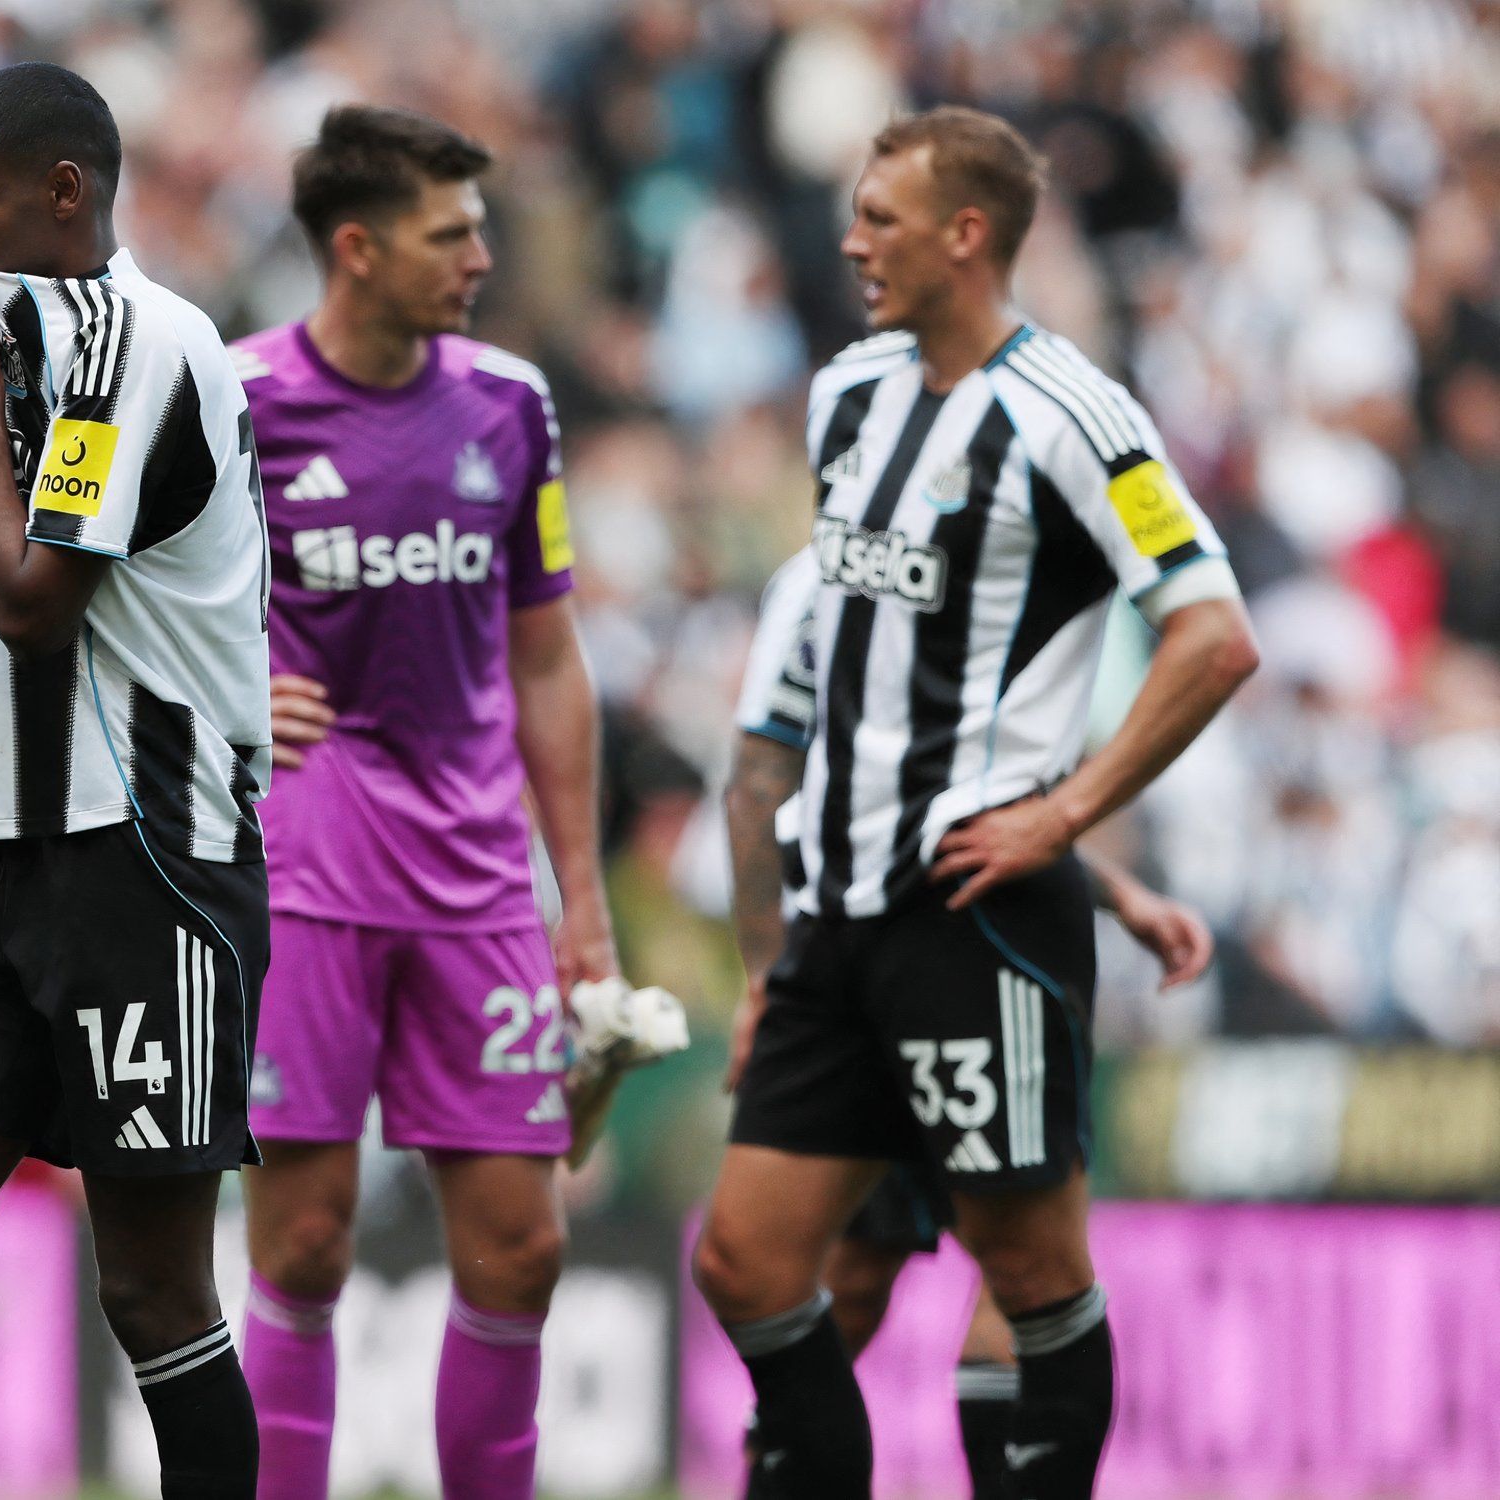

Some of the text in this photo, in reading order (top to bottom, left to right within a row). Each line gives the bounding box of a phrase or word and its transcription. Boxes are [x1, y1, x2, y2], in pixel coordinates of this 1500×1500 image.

[39, 473, 100, 500] noon
[360, 518, 493, 588] sela
[840, 532, 938, 602] sela
[76, 1002, 172, 1100] 14
[480, 985, 564, 1075] 22
[900, 1038, 997, 1128] 33
